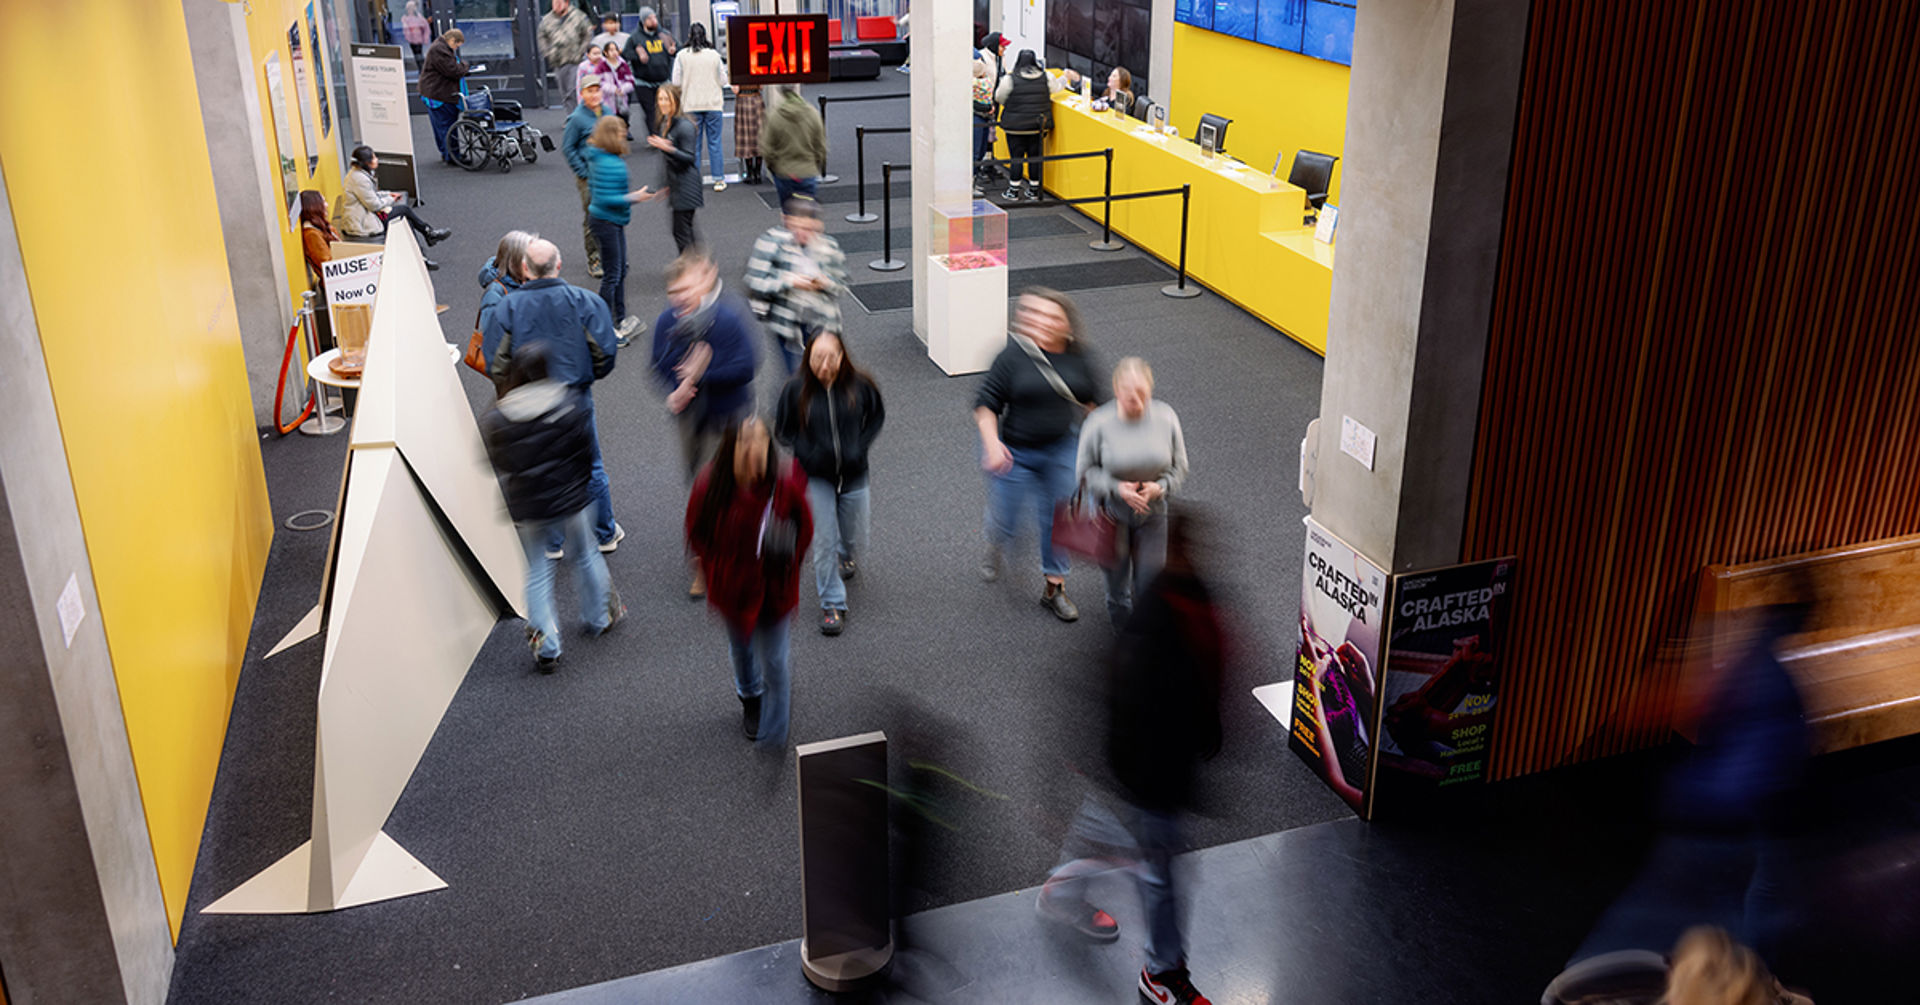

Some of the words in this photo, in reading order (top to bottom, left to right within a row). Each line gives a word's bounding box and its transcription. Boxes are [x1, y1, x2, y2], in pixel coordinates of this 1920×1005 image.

[748, 21, 815, 75] EXIT
[335, 288, 363, 301] Now
[1309, 552, 1369, 606] CRAFTED
[1316, 575, 1367, 625] ALASKA
[1400, 587, 1493, 617] CRAFTED
[1493, 582, 1506, 595] IN
[1412, 604, 1490, 633] ALASKA
[1464, 693, 1491, 708] NOV
[1451, 724, 1487, 740] SHOP
[1450, 760, 1482, 775] FREE
